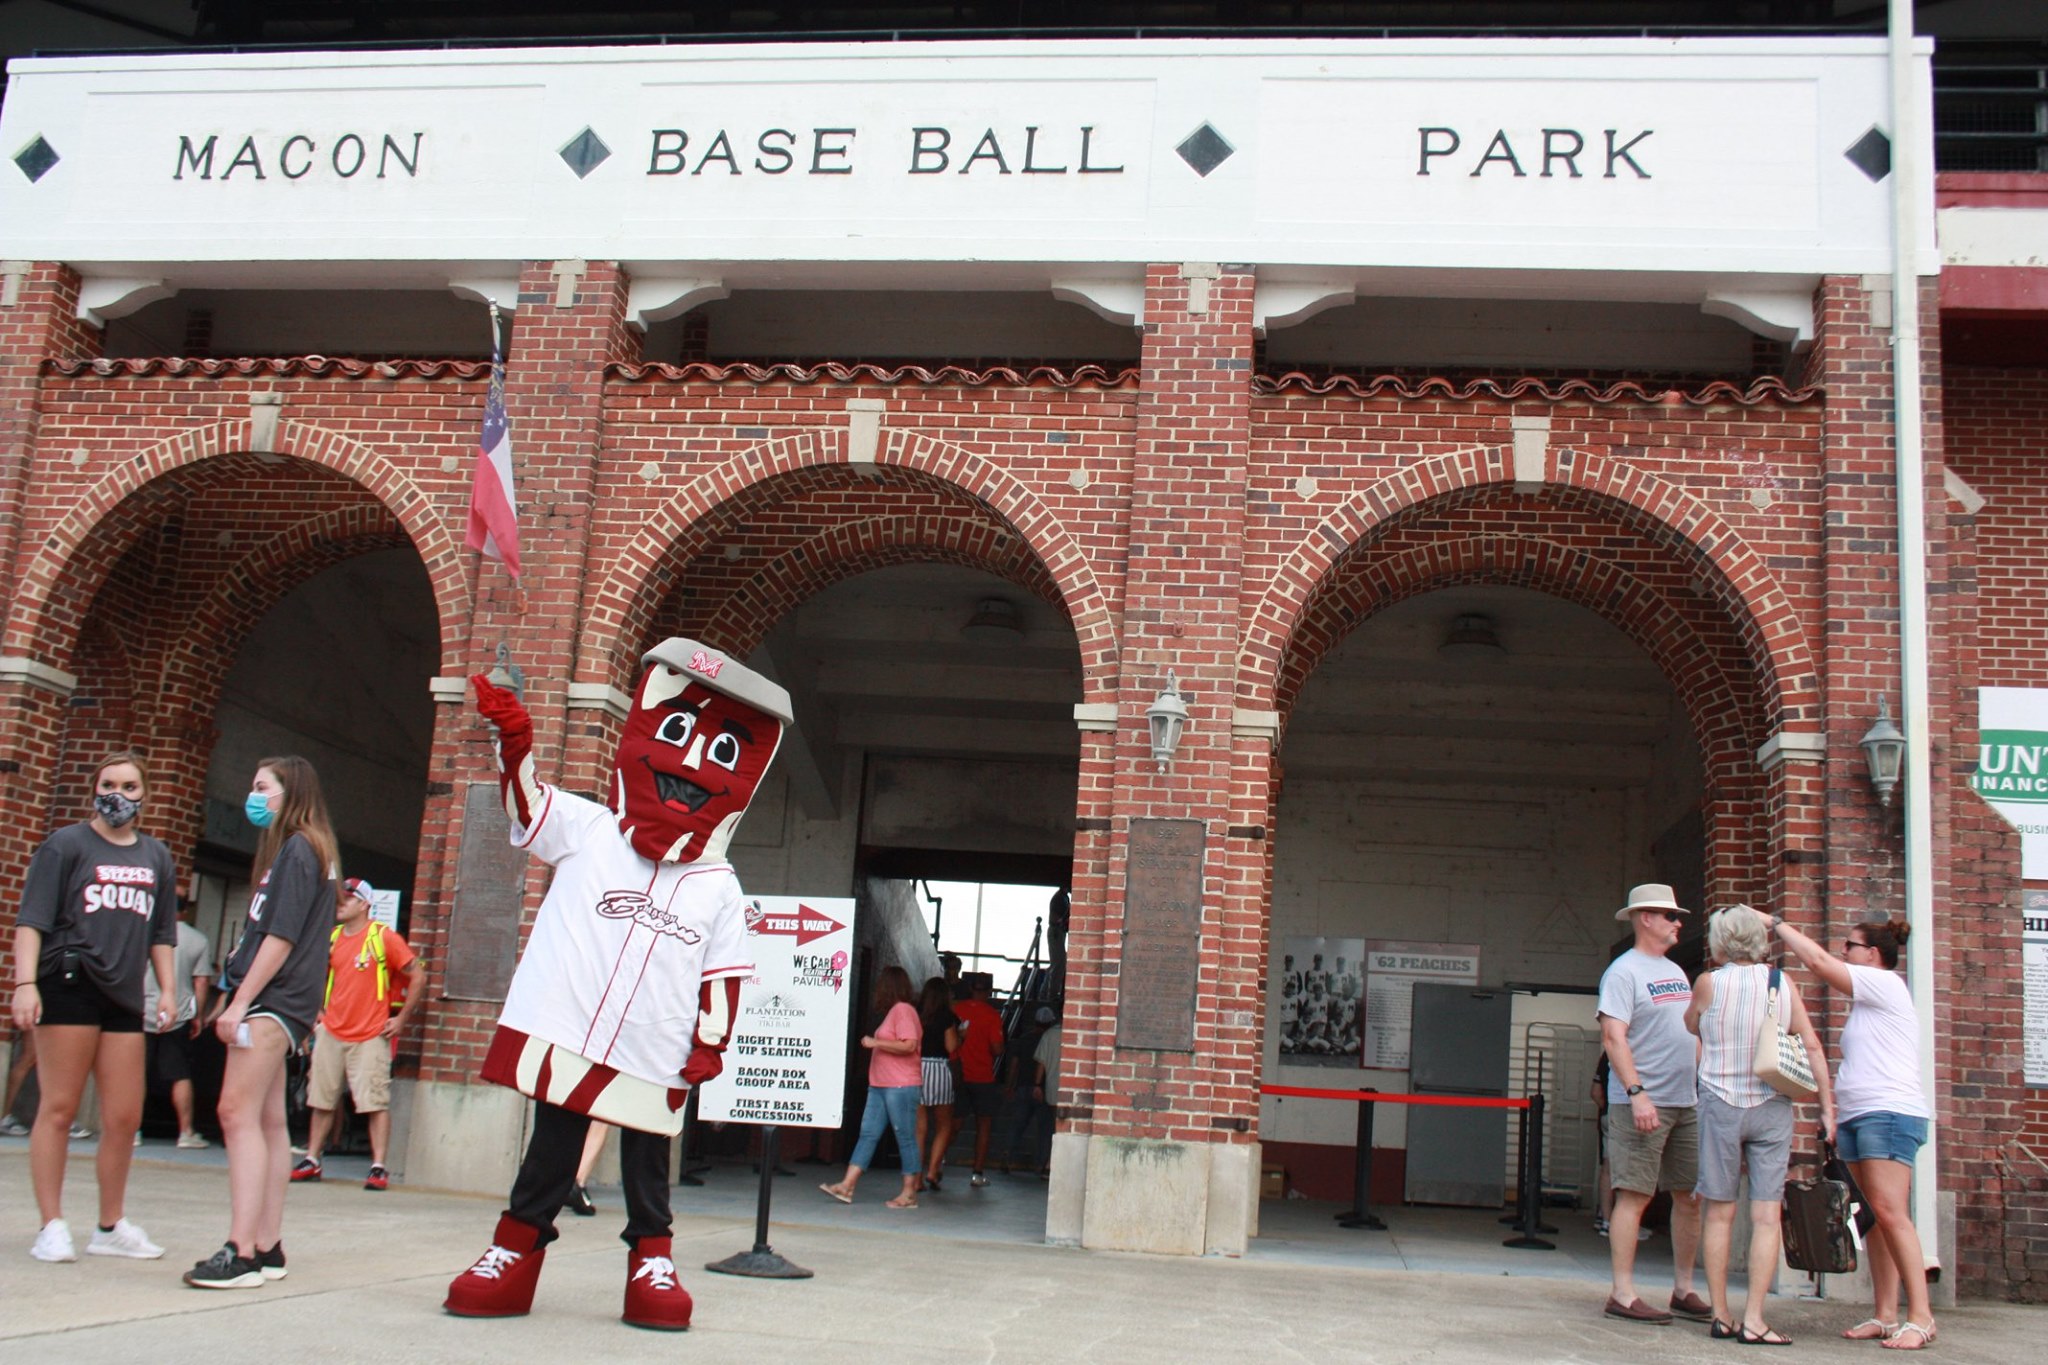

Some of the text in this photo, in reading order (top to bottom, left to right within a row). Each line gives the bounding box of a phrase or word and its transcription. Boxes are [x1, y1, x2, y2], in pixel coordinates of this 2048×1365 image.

[173, 126, 1654, 179] MACON BASE BALL PARK
[687, 650, 723, 679] M
[1979, 743, 2048, 775] UN
[766, 918, 834, 932] THIS WAY
[1400, 957, 1471, 972] PEACHES
[793, 976, 843, 988] PAVILION
[745, 1007, 806, 1017] PLANTATION
[737, 1035, 811, 1048] RIGHT FIELD
[738, 1045, 812, 1059] VIP SEATING
[738, 1066, 807, 1080] BACON BOX
[735, 1077, 811, 1091] GROUP AREA
[736, 1098, 805, 1112] FIRST BASE
[729, 1108, 813, 1123] CONCESSIONS
